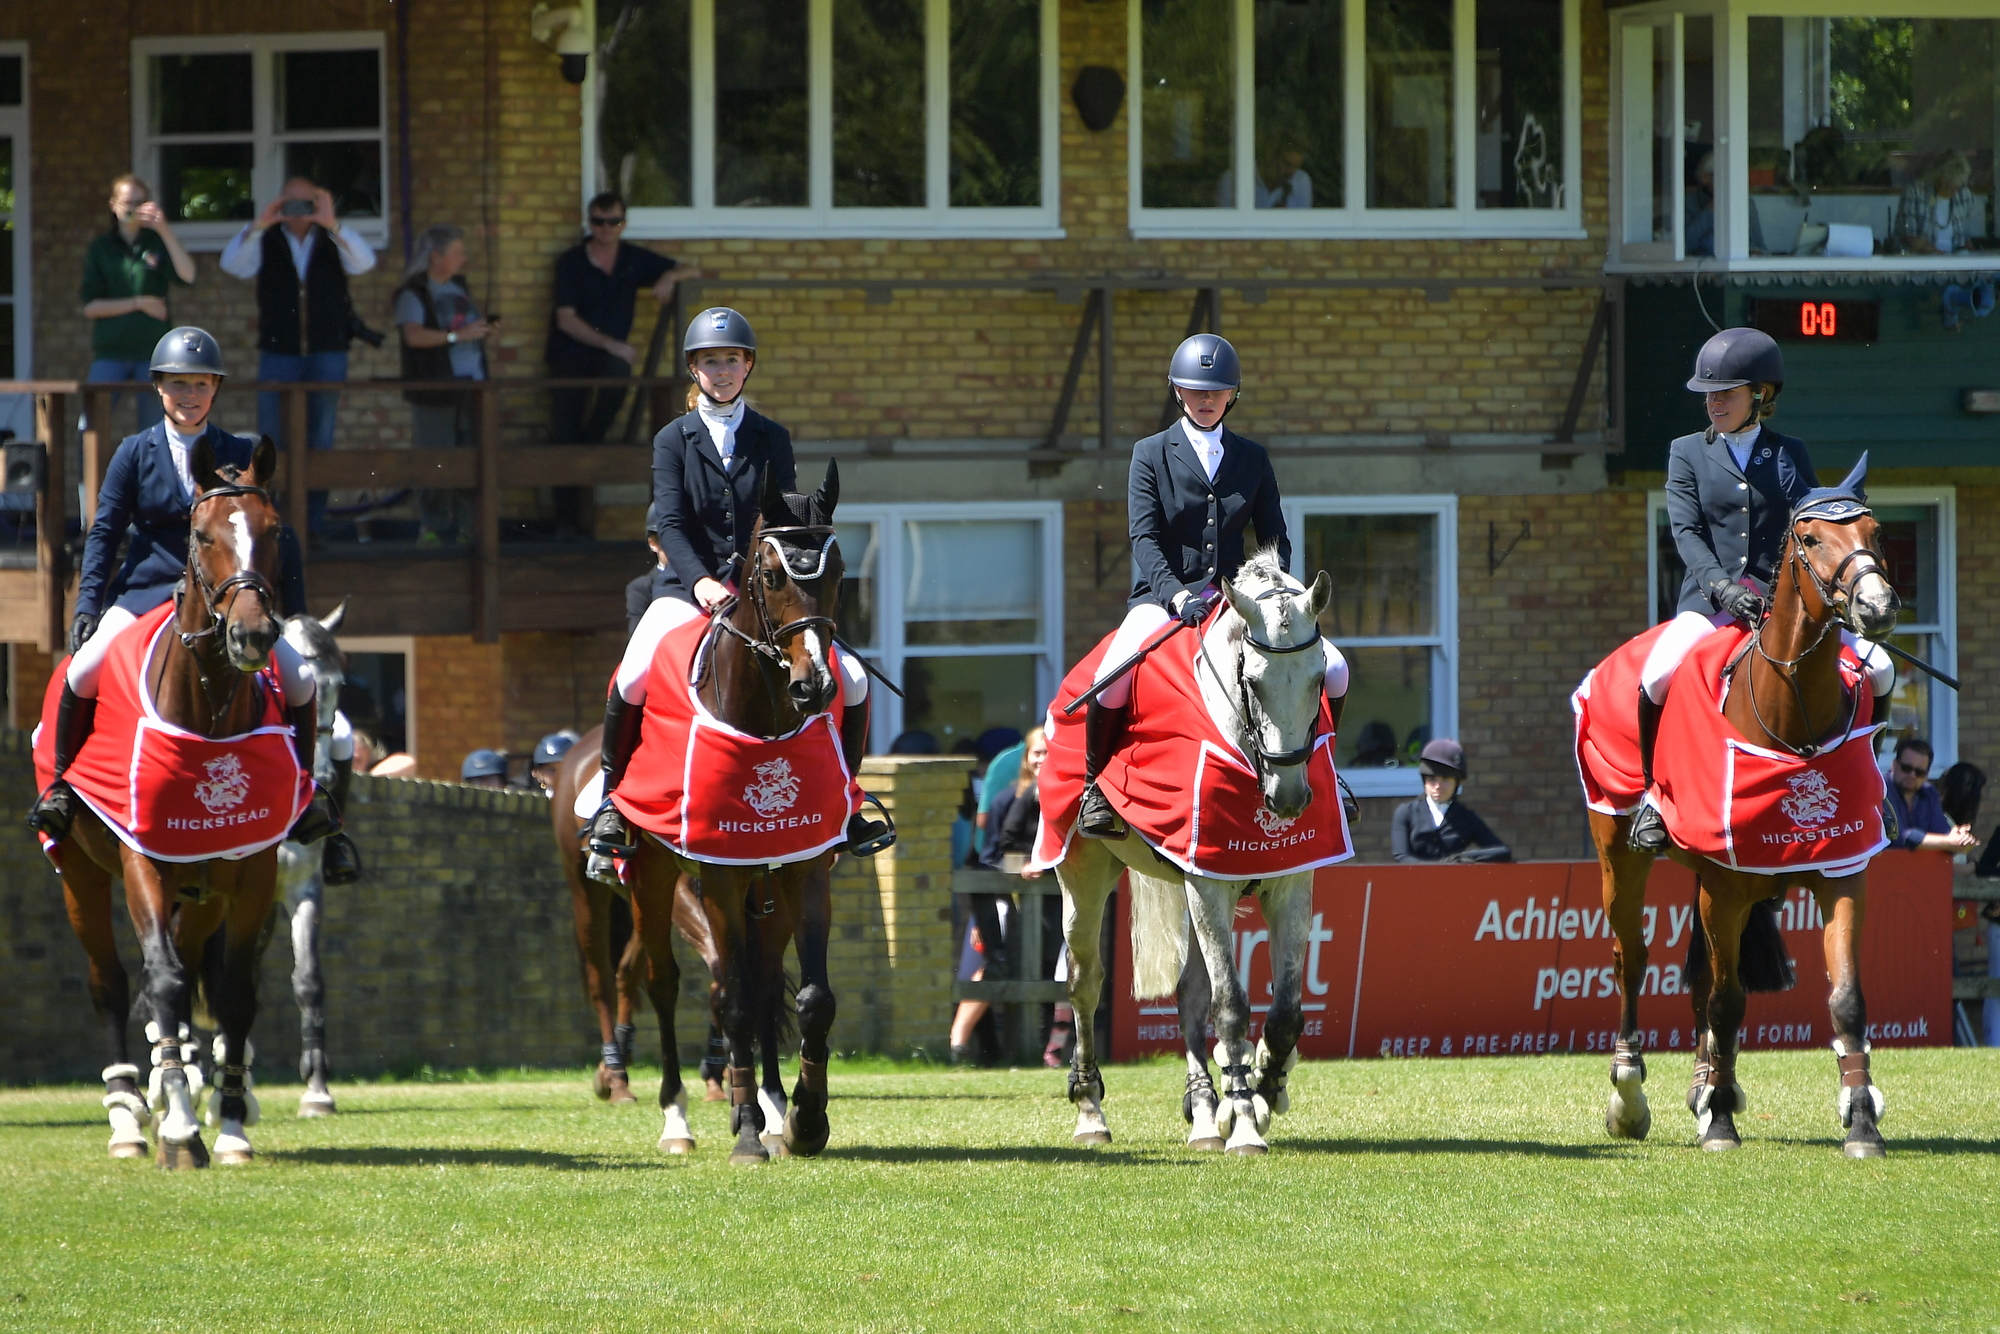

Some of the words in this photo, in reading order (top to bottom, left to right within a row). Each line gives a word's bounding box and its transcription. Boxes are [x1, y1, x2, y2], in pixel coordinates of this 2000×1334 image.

[166, 808, 270, 830] HICKSTEAD
[718, 813, 822, 833] HICKSTEAD
[1227, 829, 1316, 851] HICKSTEAD
[1762, 820, 1864, 844] HICKSTEAD
[1379, 1037, 1432, 1056] PREP
[1440, 1036, 1453, 1055] &
[1463, 1033, 1560, 1054] PRE-PREP
[1669, 1028, 1681, 1048] &
[1757, 1023, 1813, 1044] FORM
